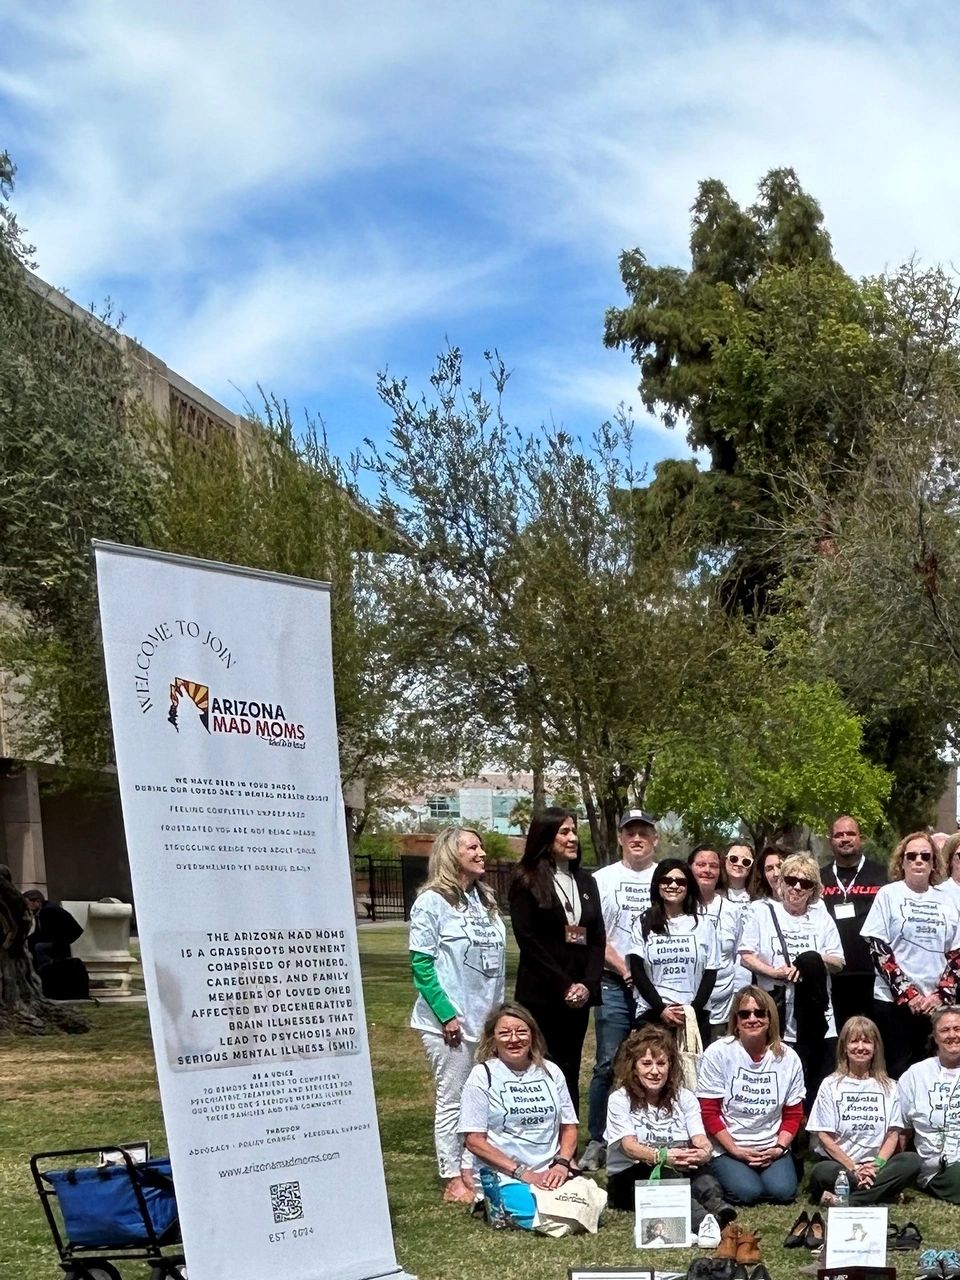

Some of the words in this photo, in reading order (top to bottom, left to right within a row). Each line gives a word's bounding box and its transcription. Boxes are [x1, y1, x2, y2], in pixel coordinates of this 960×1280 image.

[134, 622, 172, 714] WELCOME
[175, 620, 200, 638] TO
[202, 630, 236, 669] JOIN
[211, 698, 286, 720] ARIZONA
[213, 715, 251, 735] MAD
[256, 721, 305, 740] MOMS
[207, 933, 229, 941] THE
[234, 932, 284, 941] ARIZONA
[288, 931, 312, 940] MAD
[316, 930, 345, 939] MOMS
[181, 949, 192, 958] IS
[198, 948, 205, 958] A
[210, 946, 285, 957] GRASSROOTS
[288, 944, 346, 954] MOVEMENT
[207, 961, 274, 972] COMPRISED
[278, 961, 291, 969] OF
[286, 974, 308, 983] AND
[312, 972, 349, 982] FAMILY
[208, 990, 263, 1002] MEMBERS
[267, 989, 281, 998] OF
[286, 987, 320, 997] LOVED
[324, 985, 351, 995] ONES
[191, 1006, 250, 1019] AFFECTED
[254, 1005, 268, 1014] BY
[272, 999, 353, 1013] DEGENERATIVE
[229, 1020, 263, 1031] BRAIN
[267, 1015, 325, 1027] ILLNESSES
[328, 1013, 354, 1022] THAT
[219, 1035, 249, 1046] LEAD
[253, 1034, 267, 1043] TO
[271, 1028, 331, 1041] PSYCHOSIS
[335, 1027, 356, 1036] AND
[177, 1052, 228, 1066] SERIOUS
[232, 1048, 277, 1060] MENTAL
[281, 1044, 324, 1055] ILLNESS
